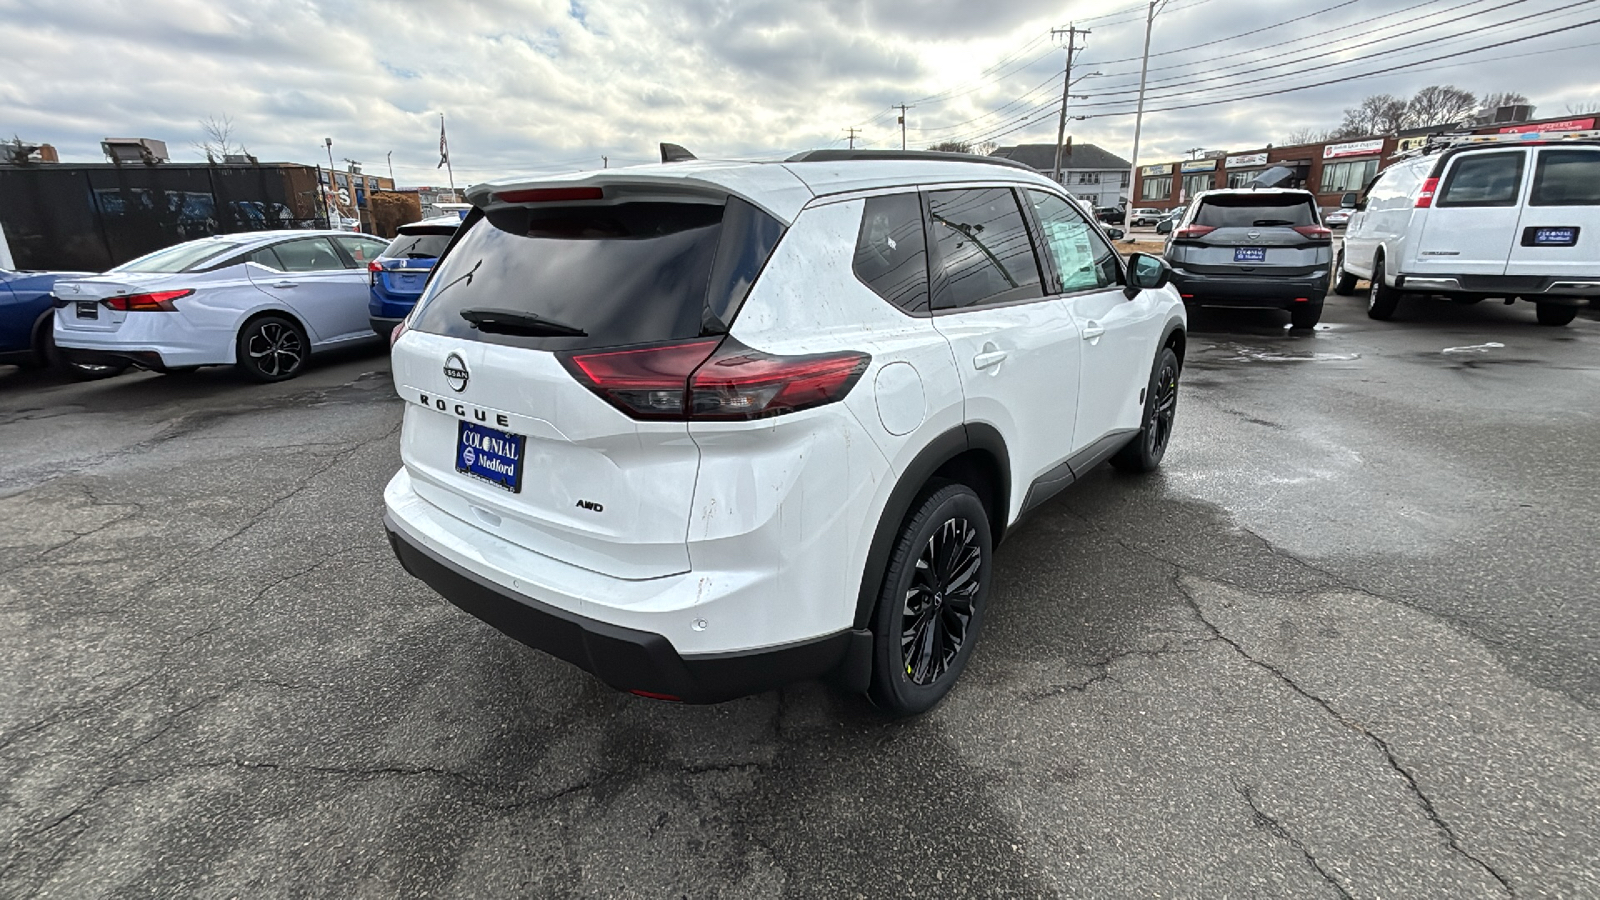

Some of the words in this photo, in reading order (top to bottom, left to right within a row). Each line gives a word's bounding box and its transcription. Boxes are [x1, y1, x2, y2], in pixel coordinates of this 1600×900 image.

[420, 394, 509, 427] ROGUE
[463, 430, 519, 460] COLONIAL
[478, 453, 515, 476] Medford
[575, 499, 604, 513] AWD
